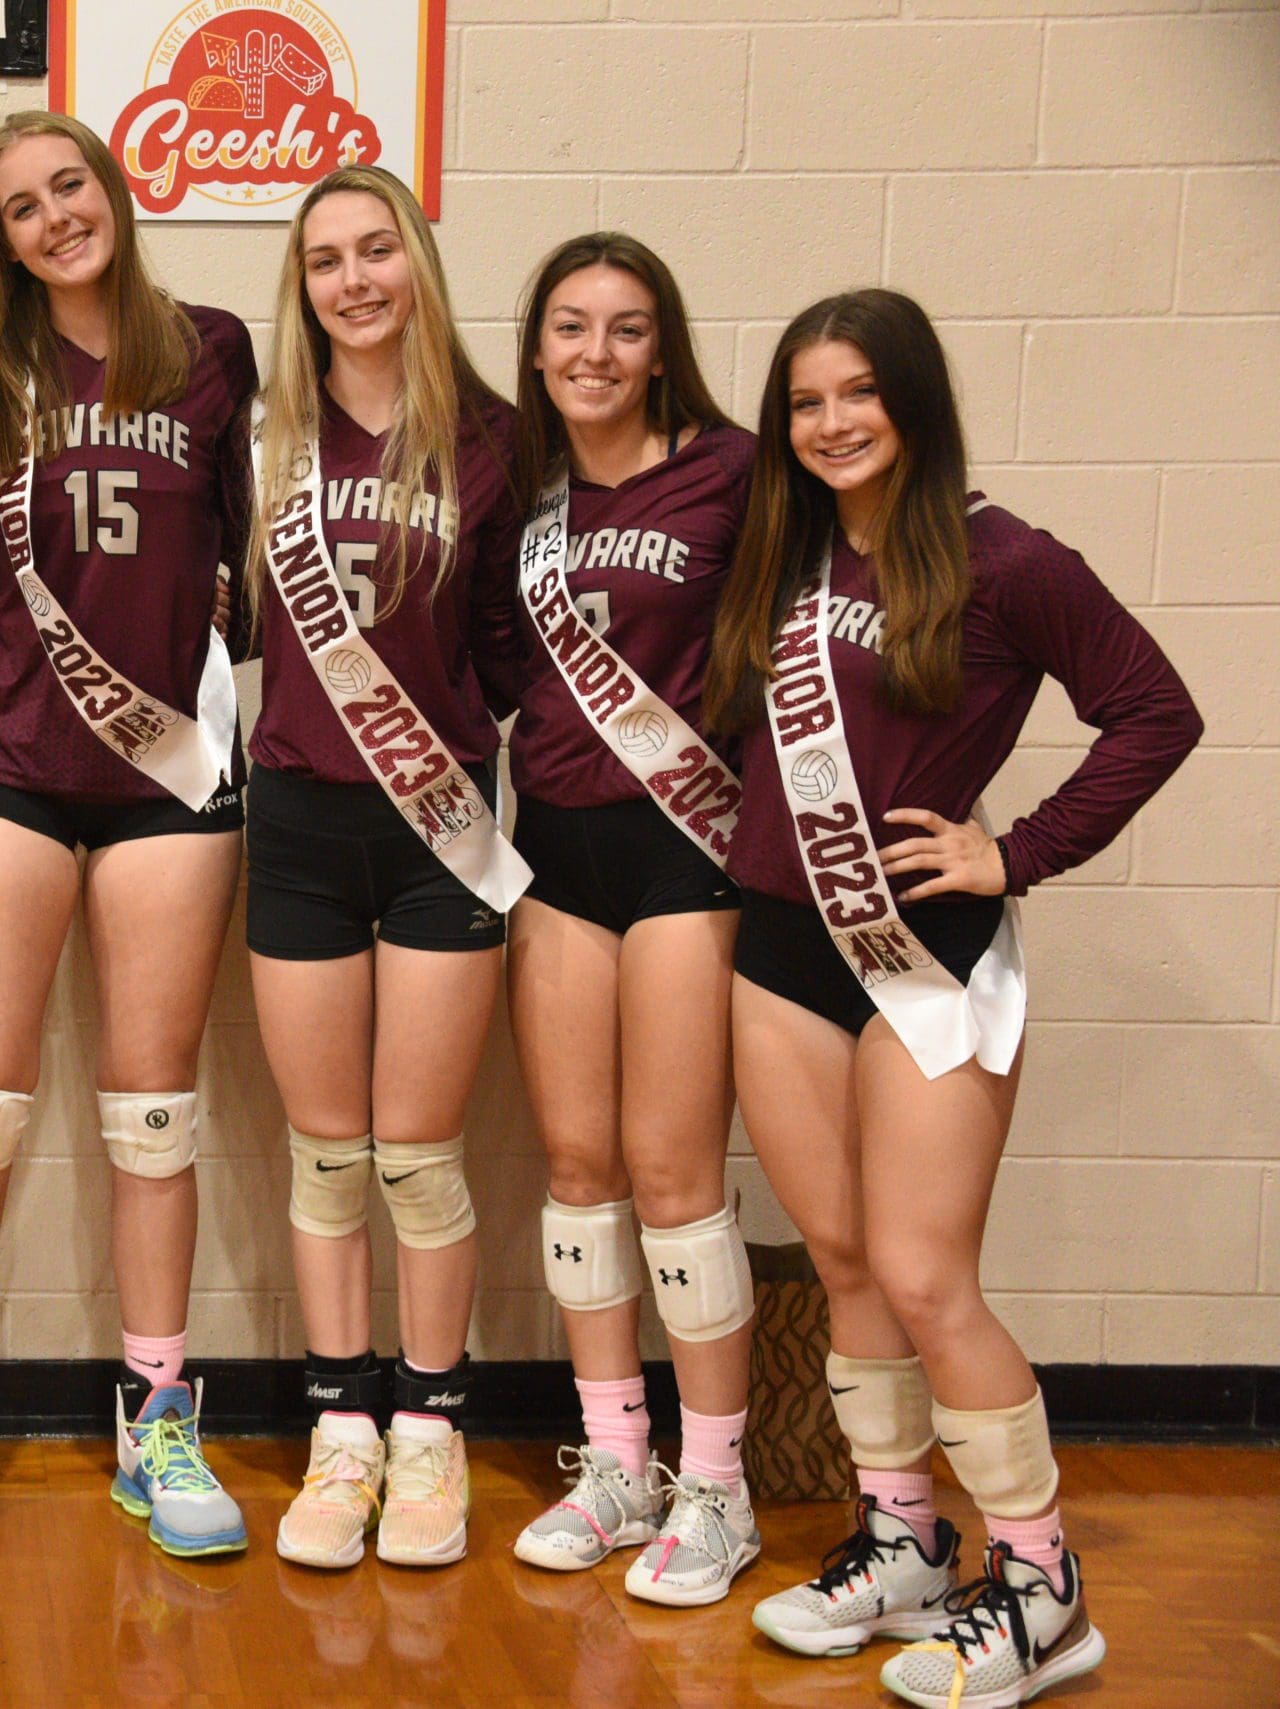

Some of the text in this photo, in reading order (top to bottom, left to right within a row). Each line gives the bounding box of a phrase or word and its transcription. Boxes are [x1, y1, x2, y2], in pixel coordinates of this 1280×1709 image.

[156, 0, 346, 66] TASTE THE AMERICAN SOUTHWEST
[123, 98, 367, 199] Geesh's
[63, 469, 139, 556] 15
[320, 475, 458, 547] VARRE
[522, 521, 562, 573] #2
[565, 528, 690, 584] VARRE
[268, 490, 349, 654] SENIOR
[333, 541, 379, 629] 5
[39, 619, 133, 721] 2023
[528, 566, 636, 725] SENIOR
[341, 684, 450, 797] 2023
[798, 802, 888, 928] 2023
